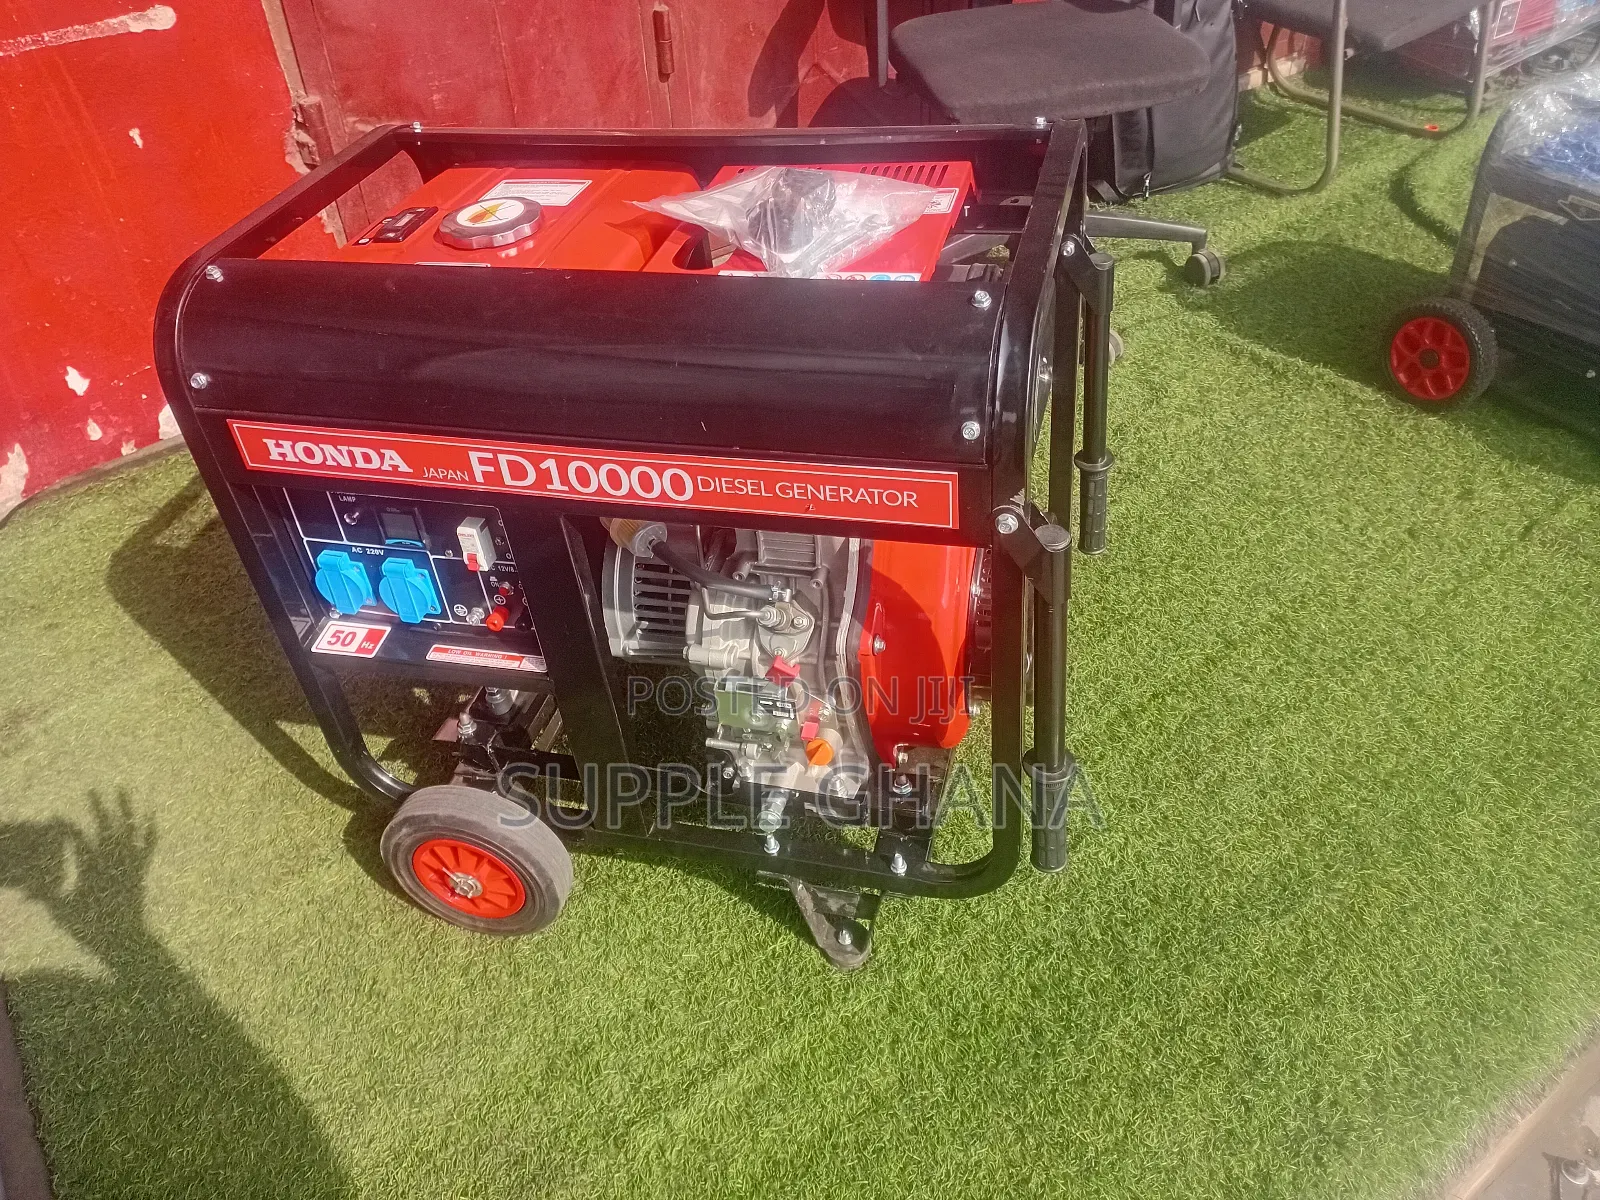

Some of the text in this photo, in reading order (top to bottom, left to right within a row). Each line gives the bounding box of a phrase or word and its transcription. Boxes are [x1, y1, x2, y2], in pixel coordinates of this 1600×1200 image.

[262, 438, 919, 508] HONDA JAPAN FD10000 DIESEL GENERATOR
[338, 495, 356, 503] LAMP
[351, 546, 384, 556] AC 220V
[326, 629, 374, 650] 50 Hz
[447, 648, 461, 656] LOW
[475, 651, 503, 660] WARNING
